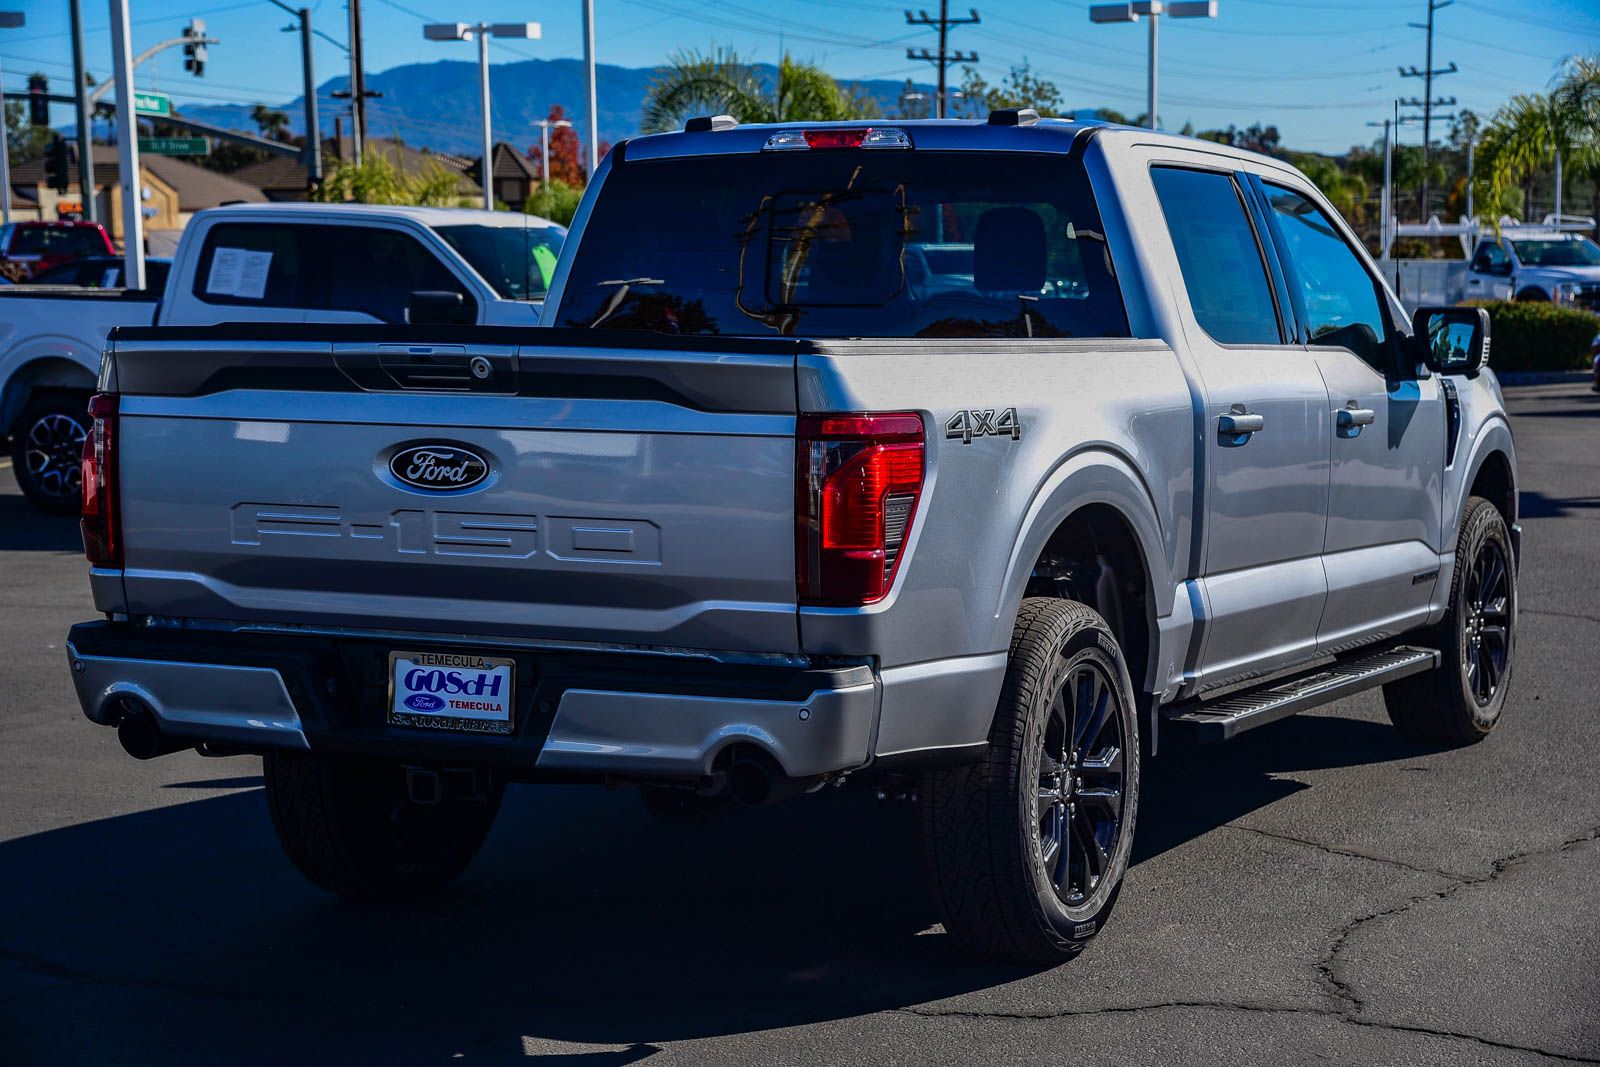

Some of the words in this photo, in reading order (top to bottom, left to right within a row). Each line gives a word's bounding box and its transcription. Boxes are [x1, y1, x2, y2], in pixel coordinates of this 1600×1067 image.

[407, 451, 469, 482] Ford
[230, 501, 662, 566] F-150
[419, 654, 485, 668] TEMECULA
[412, 697, 435, 709] Ford
[449, 700, 503, 713] TEMECULA
